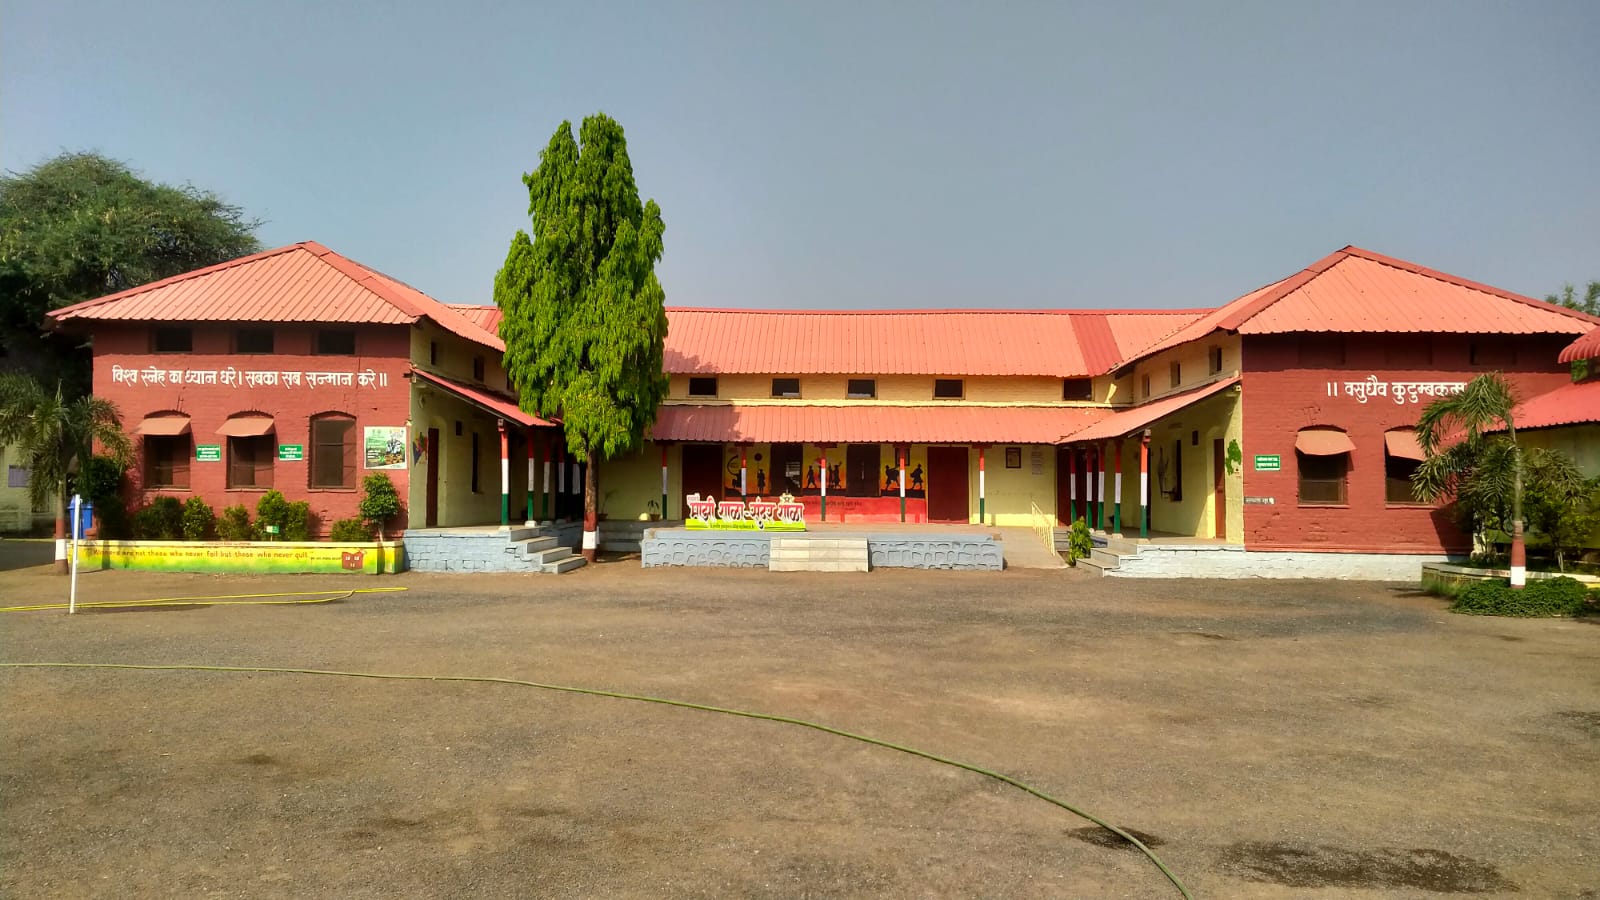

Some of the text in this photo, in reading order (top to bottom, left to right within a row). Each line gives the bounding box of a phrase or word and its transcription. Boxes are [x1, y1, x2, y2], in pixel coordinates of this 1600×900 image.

[112, 365, 138, 387] विश्व
[141, 366, 166, 387] स्नेह
[169, 370, 182, 384] का
[185, 370, 217, 385] ध्यान
[245, 371, 278, 388] सबका
[281, 371, 302, 389] सब
[305, 372, 353, 389] सन्मान
[1344, 374, 1388, 404] वसुधैव
